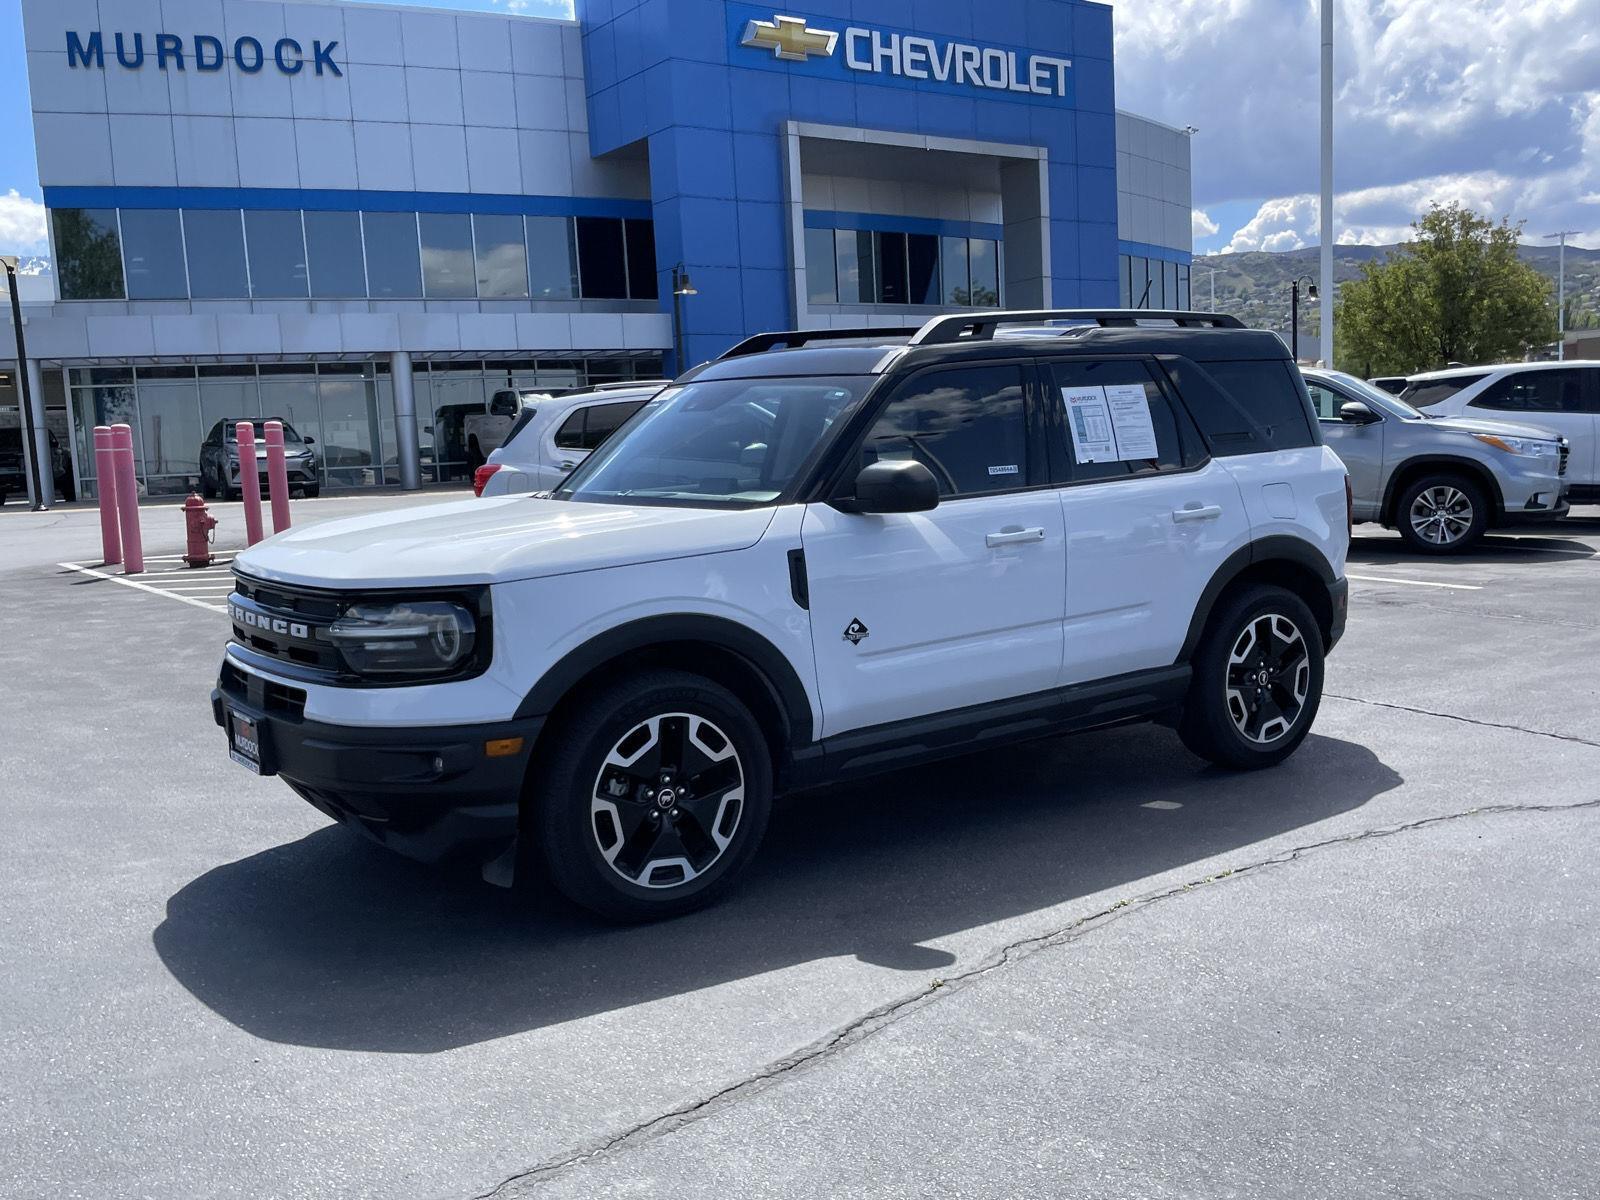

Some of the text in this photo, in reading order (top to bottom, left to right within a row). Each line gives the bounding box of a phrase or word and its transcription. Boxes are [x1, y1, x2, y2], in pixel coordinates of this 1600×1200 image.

[65, 31, 343, 77] MURDOCK
[845, 26, 1072, 97] CHEVROLET
[229, 604, 308, 638] BRONCO
